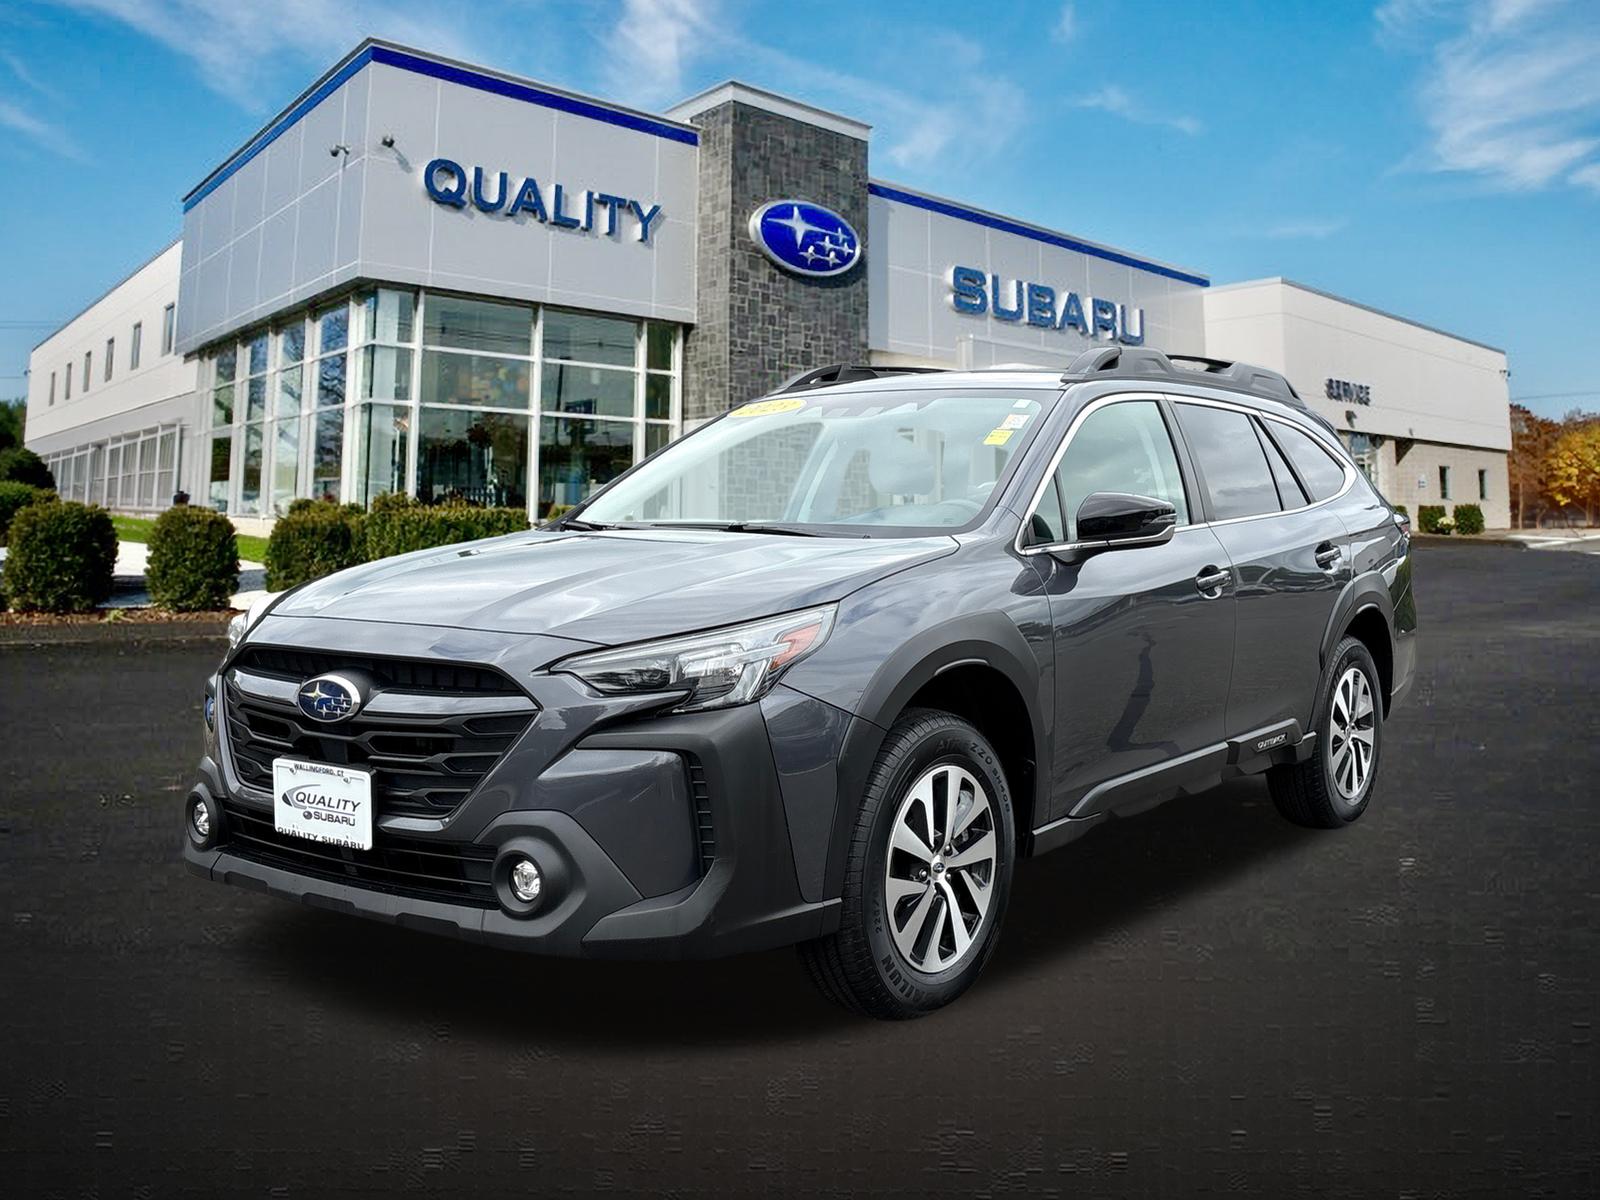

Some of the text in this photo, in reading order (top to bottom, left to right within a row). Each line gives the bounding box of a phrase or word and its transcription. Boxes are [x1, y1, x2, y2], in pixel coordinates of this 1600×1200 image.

[424, 158, 662, 243] QUALITY
[949, 265, 1145, 346] SUBARU
[337, 769, 345, 777] CT
[295, 791, 361, 812] QUALITY
[313, 811, 356, 827] SUBARU
[277, 827, 365, 850] QUALITY SUBARU
